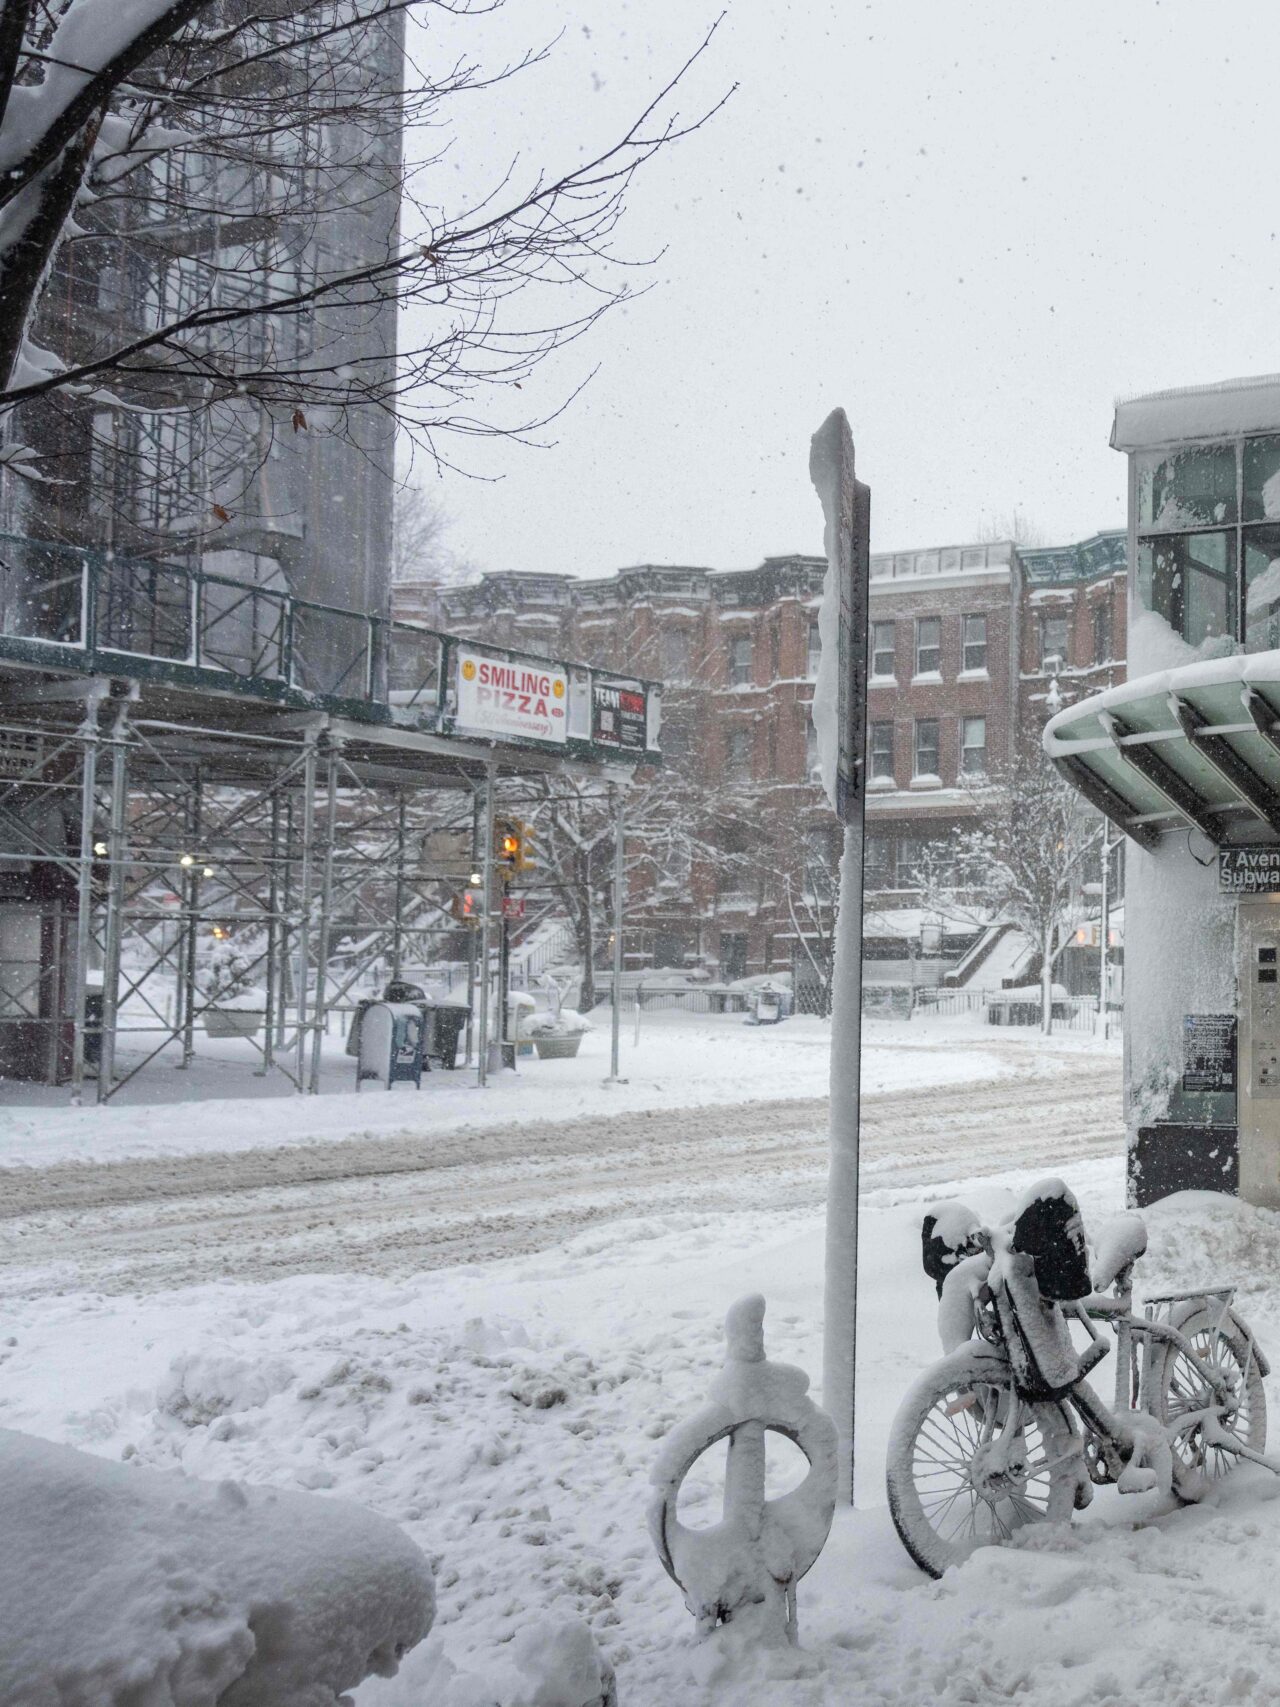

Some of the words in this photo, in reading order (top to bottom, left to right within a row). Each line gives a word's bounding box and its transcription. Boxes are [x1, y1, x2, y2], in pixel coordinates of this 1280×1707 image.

[479, 663, 550, 697] SMILING
[477, 686, 548, 718] PIZZA
[1220, 852, 1231, 867] 7
